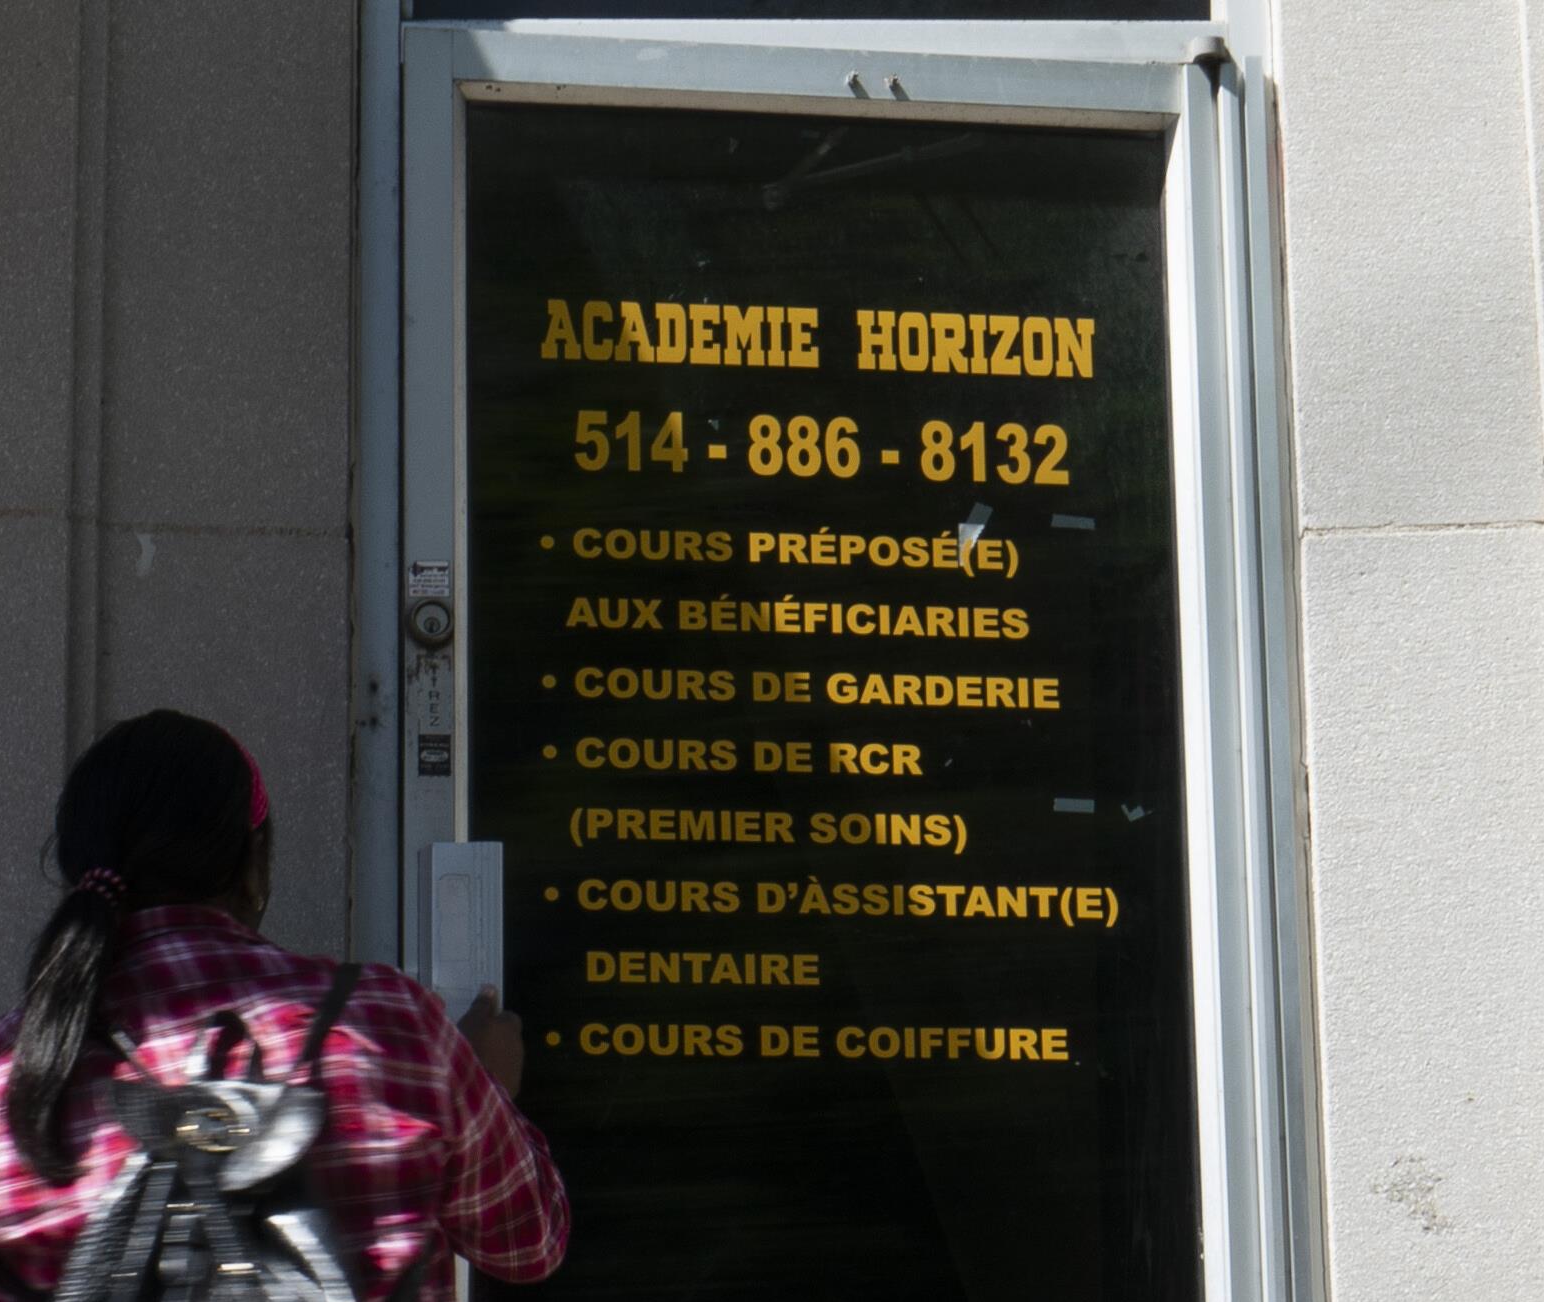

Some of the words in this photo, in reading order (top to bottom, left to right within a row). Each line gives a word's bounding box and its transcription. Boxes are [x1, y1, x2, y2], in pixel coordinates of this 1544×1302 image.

[540, 298, 820, 369] ACADEMIE
[855, 309, 1096, 379] HORIZON
[574, 410, 689, 473] 514
[746, 413, 861, 480] 886
[919, 419, 1071, 487] 8132
[573, 527, 733, 562] COURS
[747, 526, 1020, 580] PRÉPOSÉ(E)
[566, 597, 662, 631] AUX
[678, 592, 1030, 641] BÉNÉFICIARIES
[574, 666, 736, 702] COURS
[752, 671, 811, 703] DE
[824, 671, 1061, 711] GARDERIE
[575, 736, 738, 772] COURS
[754, 740, 814, 774] DE
[828, 742, 923, 777] RCR
[569, 807, 794, 847] (PREMIER
[809, 811, 968, 856] SOINS)
[577, 879, 741, 914] COURS
[586, 950, 820, 986] DENTAIRE
[579, 1023, 744, 1058] COURS
[760, 1024, 821, 1059] DE
[836, 1026, 1070, 1062] COIFFURE
